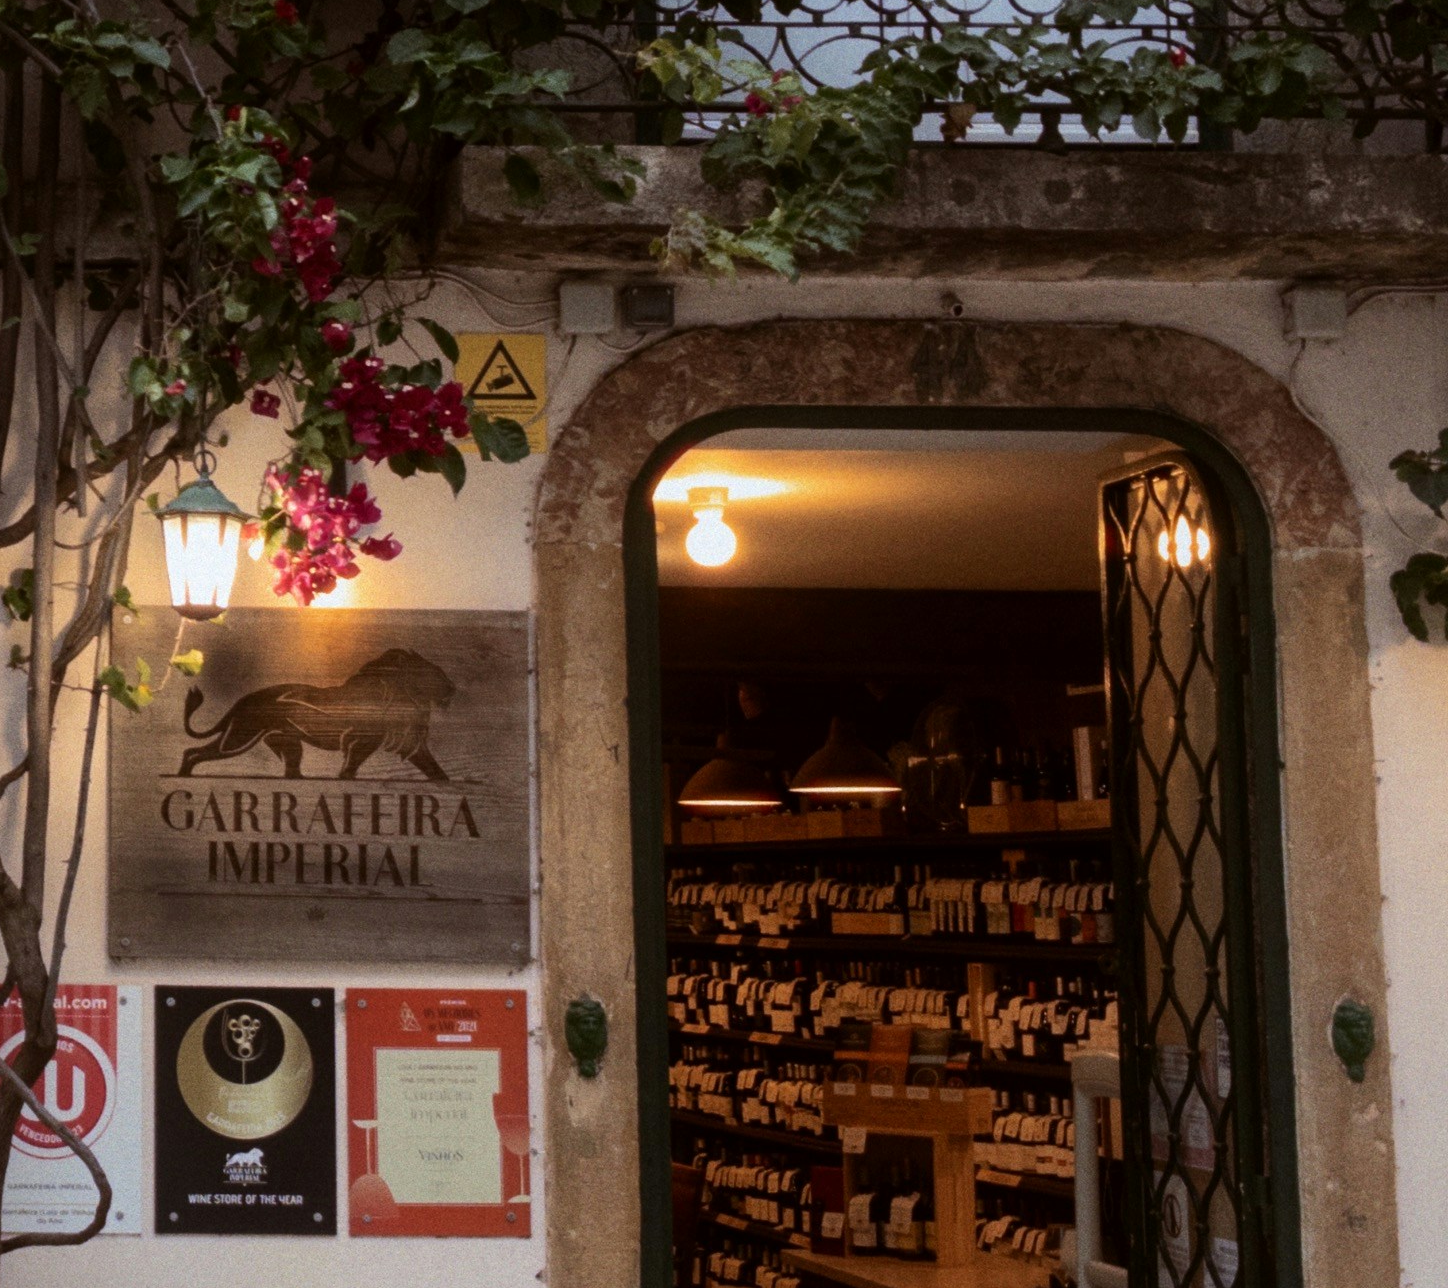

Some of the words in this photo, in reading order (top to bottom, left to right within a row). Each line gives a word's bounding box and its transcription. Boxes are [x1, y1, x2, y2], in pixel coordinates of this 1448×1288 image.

[160, 789, 481, 839] GARRAFEIRA
[206, 839, 435, 888] IMPERIAL
[187, 1193, 212, 1205] WINE
[213, 1193, 244, 1205] STORE
[244, 1193, 257, 1205] OF
[259, 1194, 277, 1206] THE
[278, 1194, 304, 1206] YEAR
